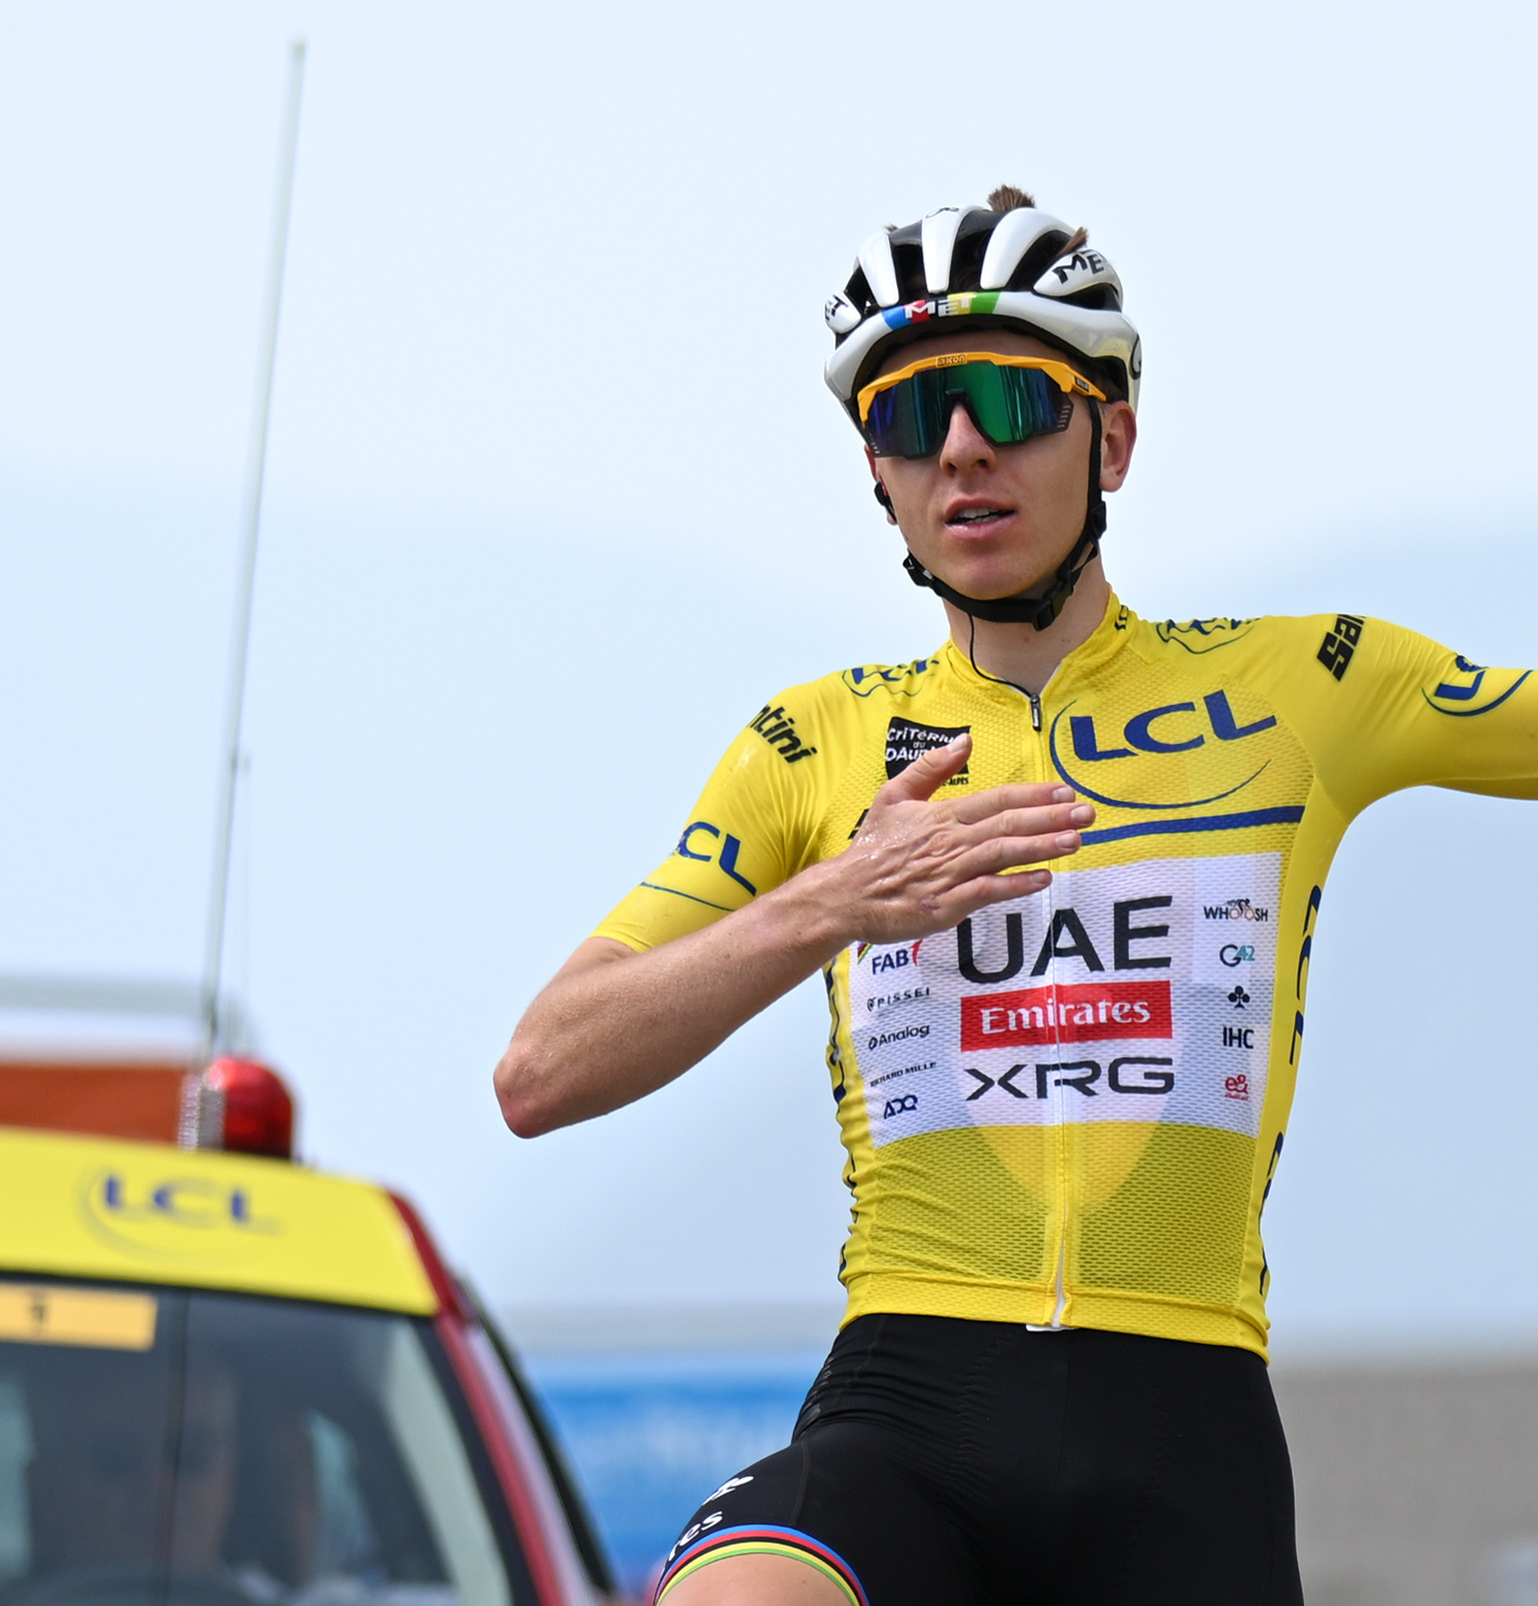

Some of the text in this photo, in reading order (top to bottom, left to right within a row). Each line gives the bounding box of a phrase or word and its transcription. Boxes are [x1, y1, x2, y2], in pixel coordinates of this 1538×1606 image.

[905, 295, 977, 321] MET
[1069, 688, 1278, 763] LCL
[912, 741, 927, 749] du
[1203, 905, 1269, 922] WHOOSH
[956, 895, 1174, 984] UAE
[871, 948, 910, 976] FAB
[1219, 943, 1256, 968] G42
[877, 986, 930, 1009] PISSEI
[980, 999, 1152, 1035] Emirates
[878, 1024, 931, 1047] Analog
[1222, 1026, 1255, 1050] IHC
[964, 1056, 1175, 1102] XRG
[103, 1169, 287, 1236] LCL
